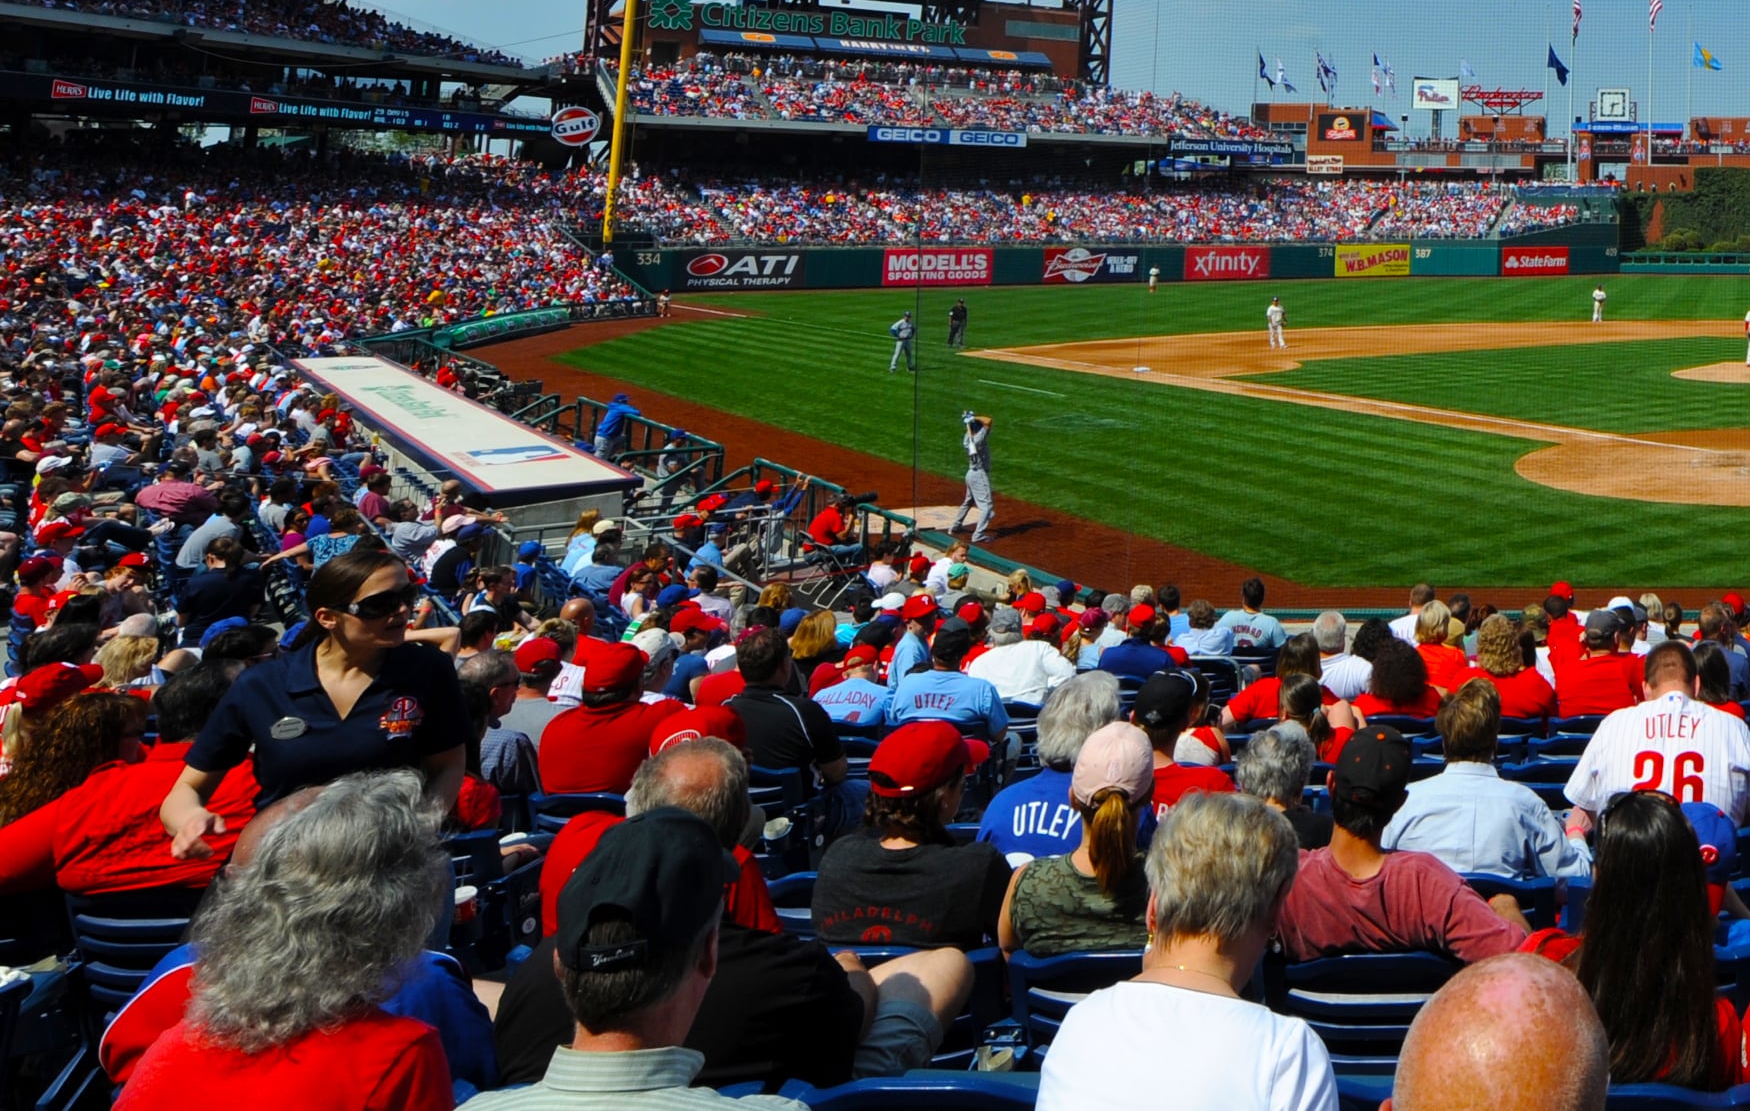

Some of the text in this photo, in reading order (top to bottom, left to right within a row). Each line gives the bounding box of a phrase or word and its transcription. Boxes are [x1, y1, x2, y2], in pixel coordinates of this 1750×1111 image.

[701, 2, 966, 45] Citizens Bank Park
[88, 87, 112, 100] Live
[115, 89, 137, 102] Life
[139, 92, 164, 104] with
[166, 94, 204, 107] Flavor!
[279, 102, 298, 115] Live
[300, 104, 317, 116] Life
[319, 106, 339, 118] with
[340, 108, 371, 121] Flavor!
[554, 119, 595, 135] Gulf
[876, 127, 1019, 145] GEICO GEICO
[1170, 140, 1292, 155] Jefferson University Hospitals
[637, 253, 661, 266] 334
[1318, 247, 1333, 258] 374
[720, 255, 800, 276] ATI
[888, 254, 988, 271] MODELL'S
[1194, 252, 1261, 276] xfinity
[687, 277, 791, 288] PHYSICAL THERAPY
[888, 270, 988, 280] SPORTING GOODS
[914, 693, 956, 711] UTLEY
[1646, 713, 1700, 739] UTLEY
[1632, 751, 1704, 803] 26
[1012, 801, 1081, 840] UTLEY
